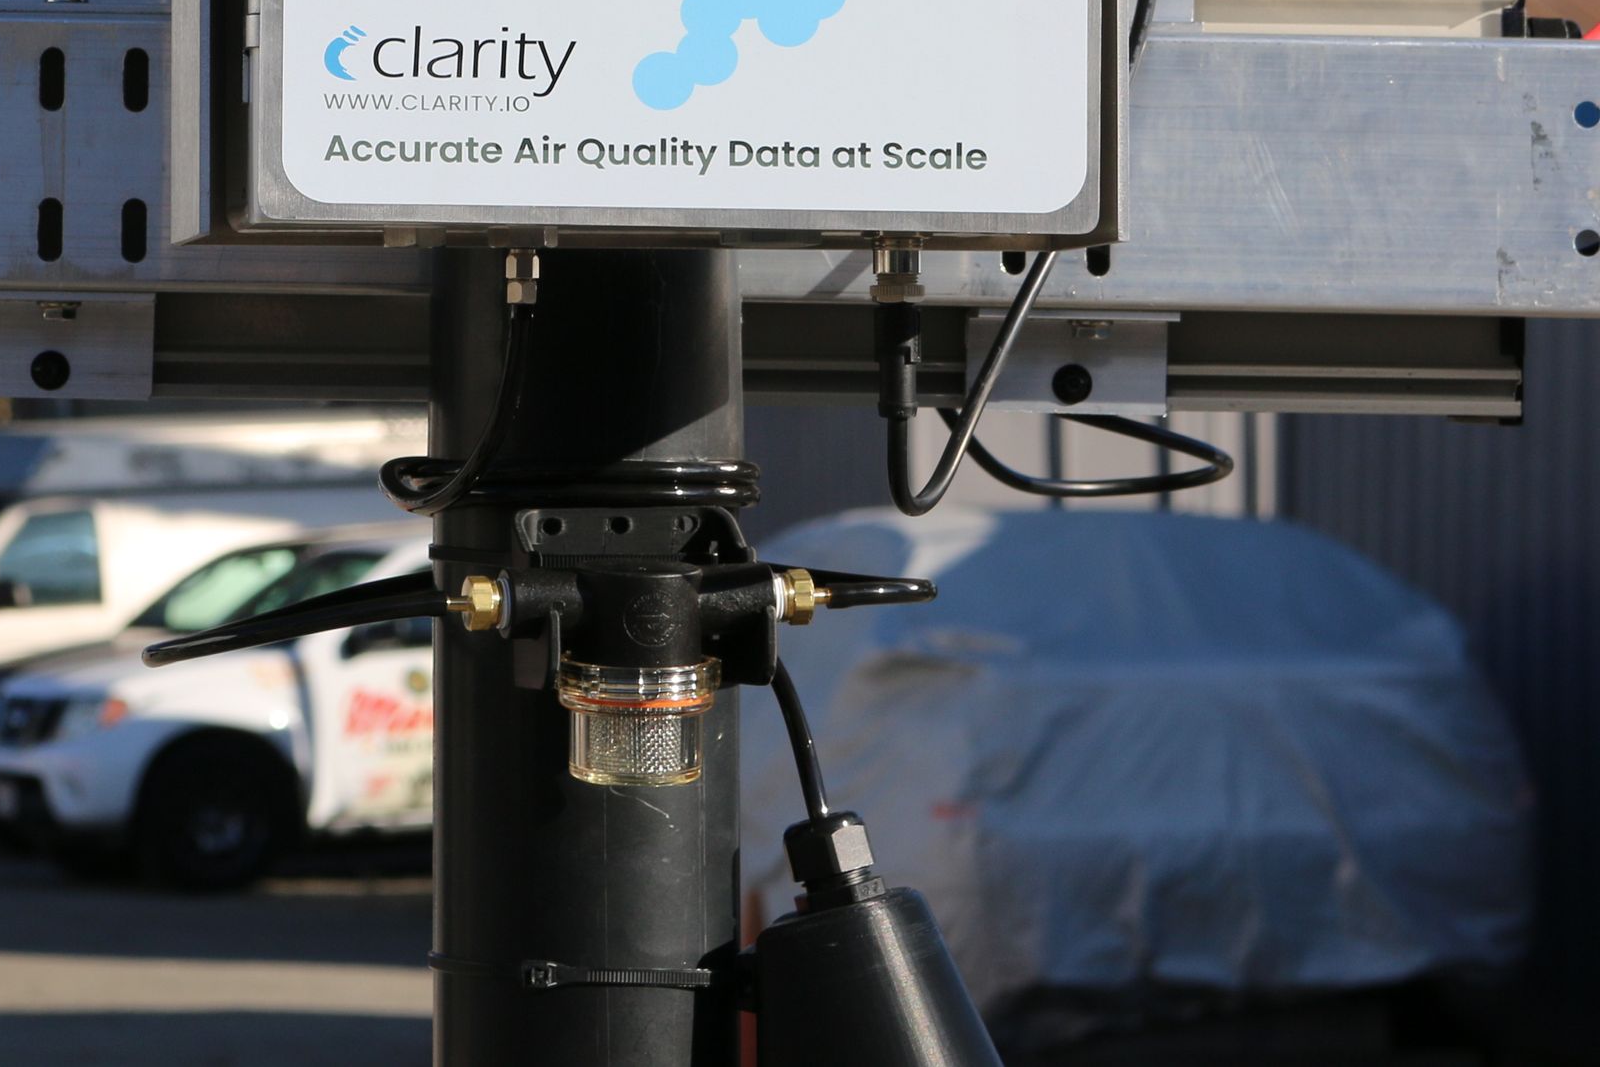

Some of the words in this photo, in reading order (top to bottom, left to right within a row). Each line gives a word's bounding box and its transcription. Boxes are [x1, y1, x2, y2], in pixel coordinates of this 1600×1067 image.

[371, 24, 578, 98] clarity
[322, 92, 531, 113] WWW.CLARITY.IO
[323, 133, 504, 165] Accurate
[513, 134, 568, 165] Air
[575, 135, 719, 177] Quality
[728, 139, 821, 169] Data
[830, 141, 873, 170] at
[881, 140, 989, 171] Scale
